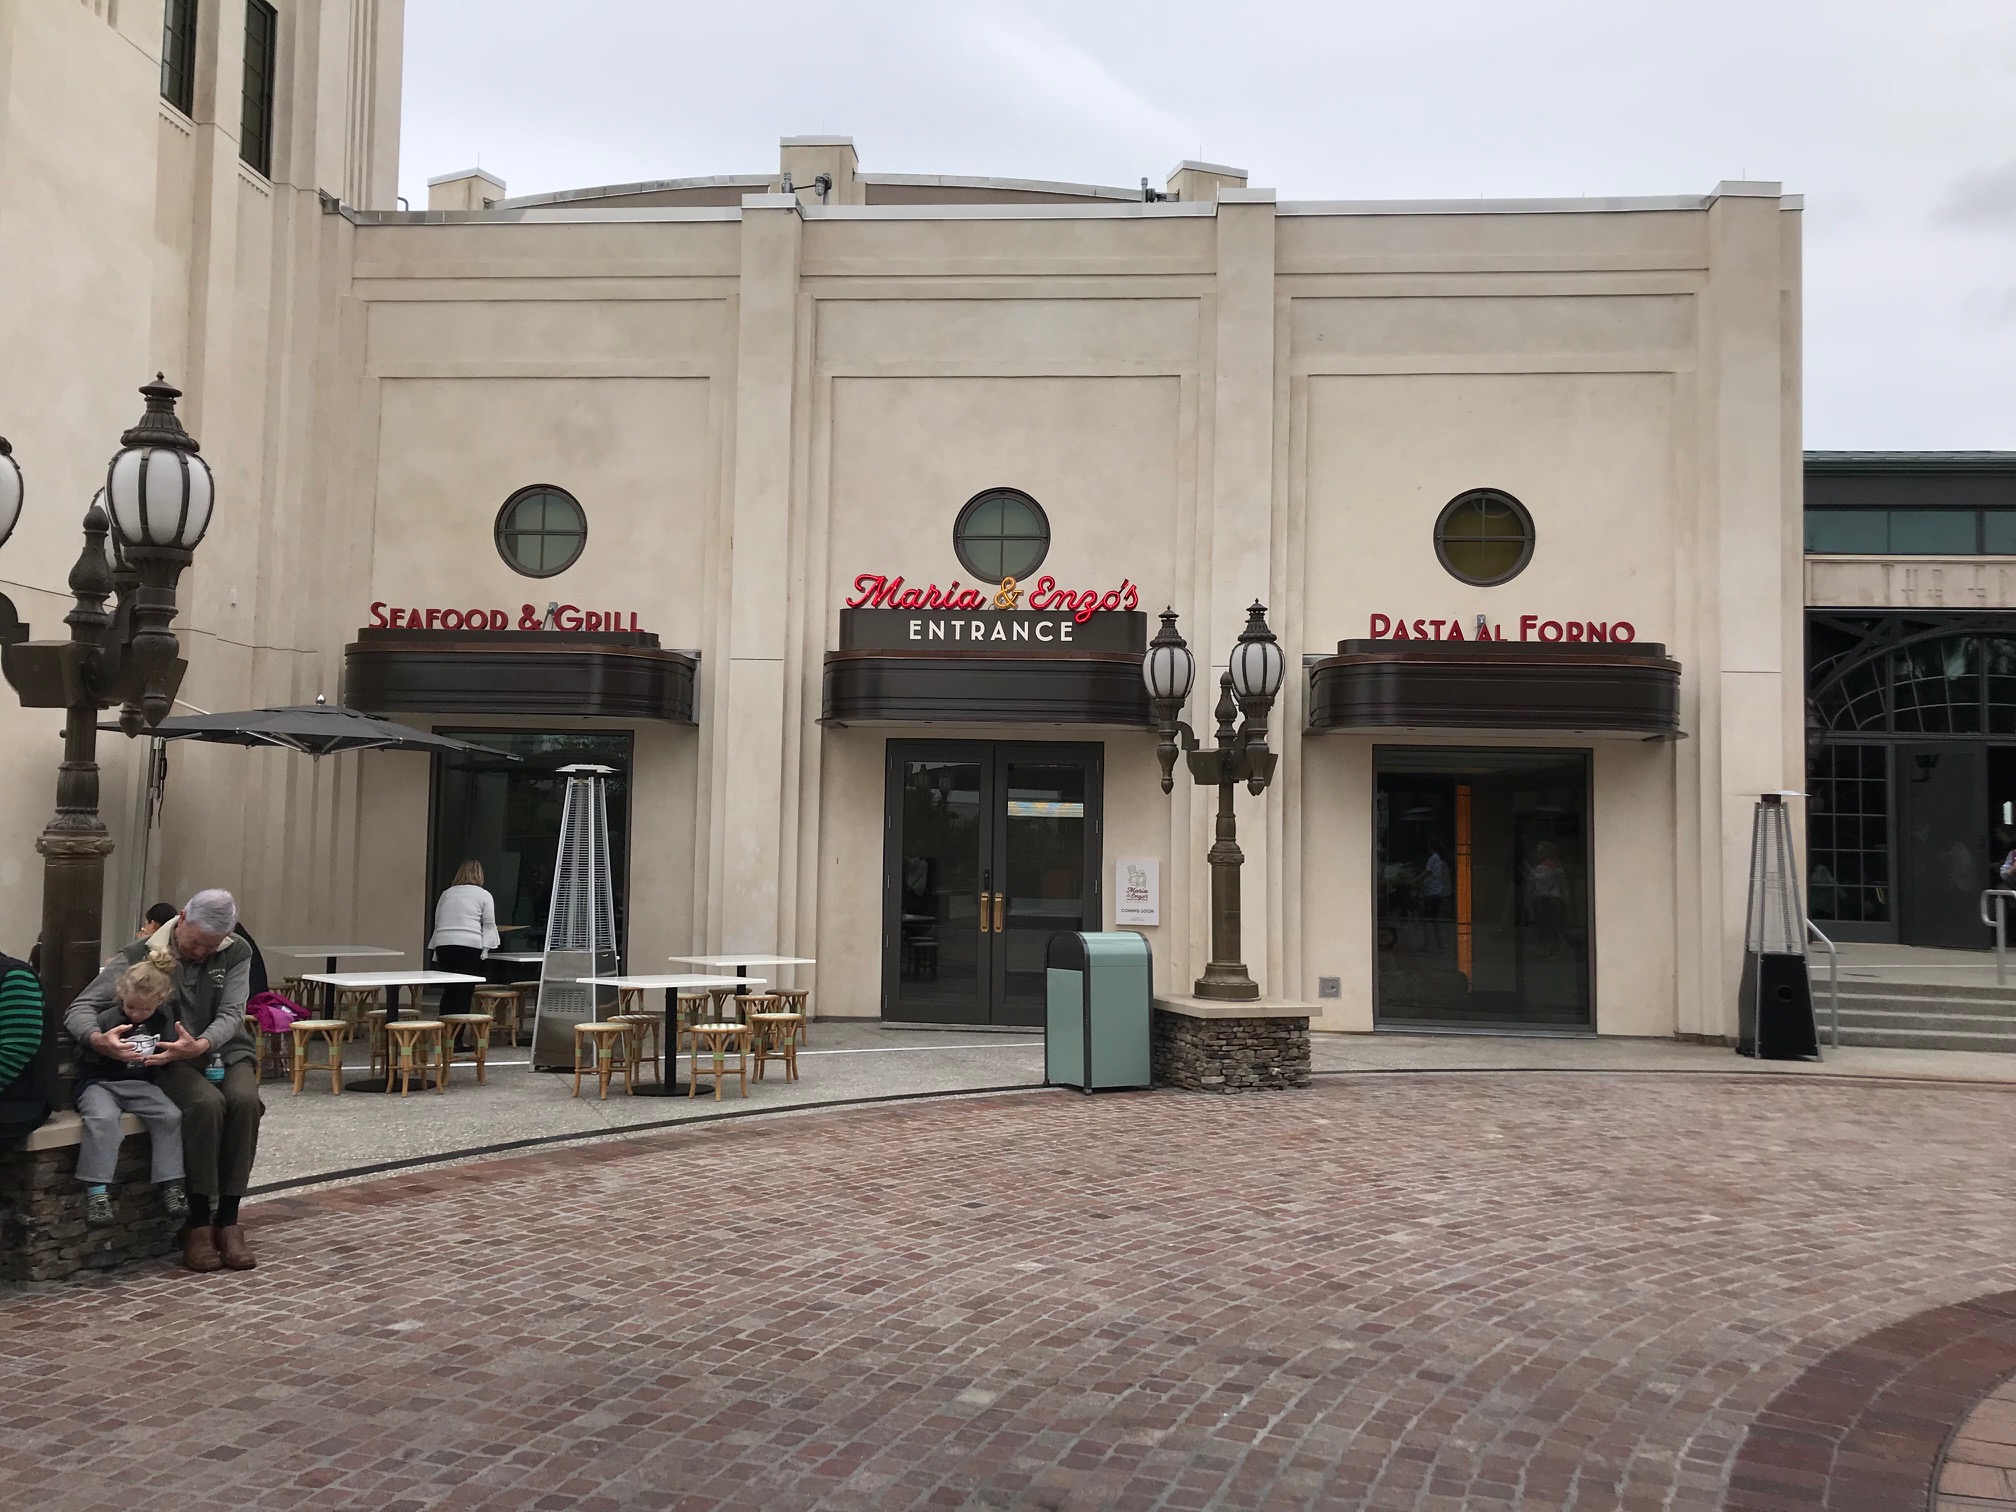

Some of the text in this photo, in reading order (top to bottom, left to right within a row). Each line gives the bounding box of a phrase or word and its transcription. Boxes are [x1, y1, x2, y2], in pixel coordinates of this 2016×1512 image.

[846, 573, 1140, 624] Maria & Enzo's
[368, 601, 645, 632] SEAFOOD & GRILL
[908, 619, 1074, 642] ENTRANCE
[1369, 613, 1636, 644] PASTA AL FORNO
